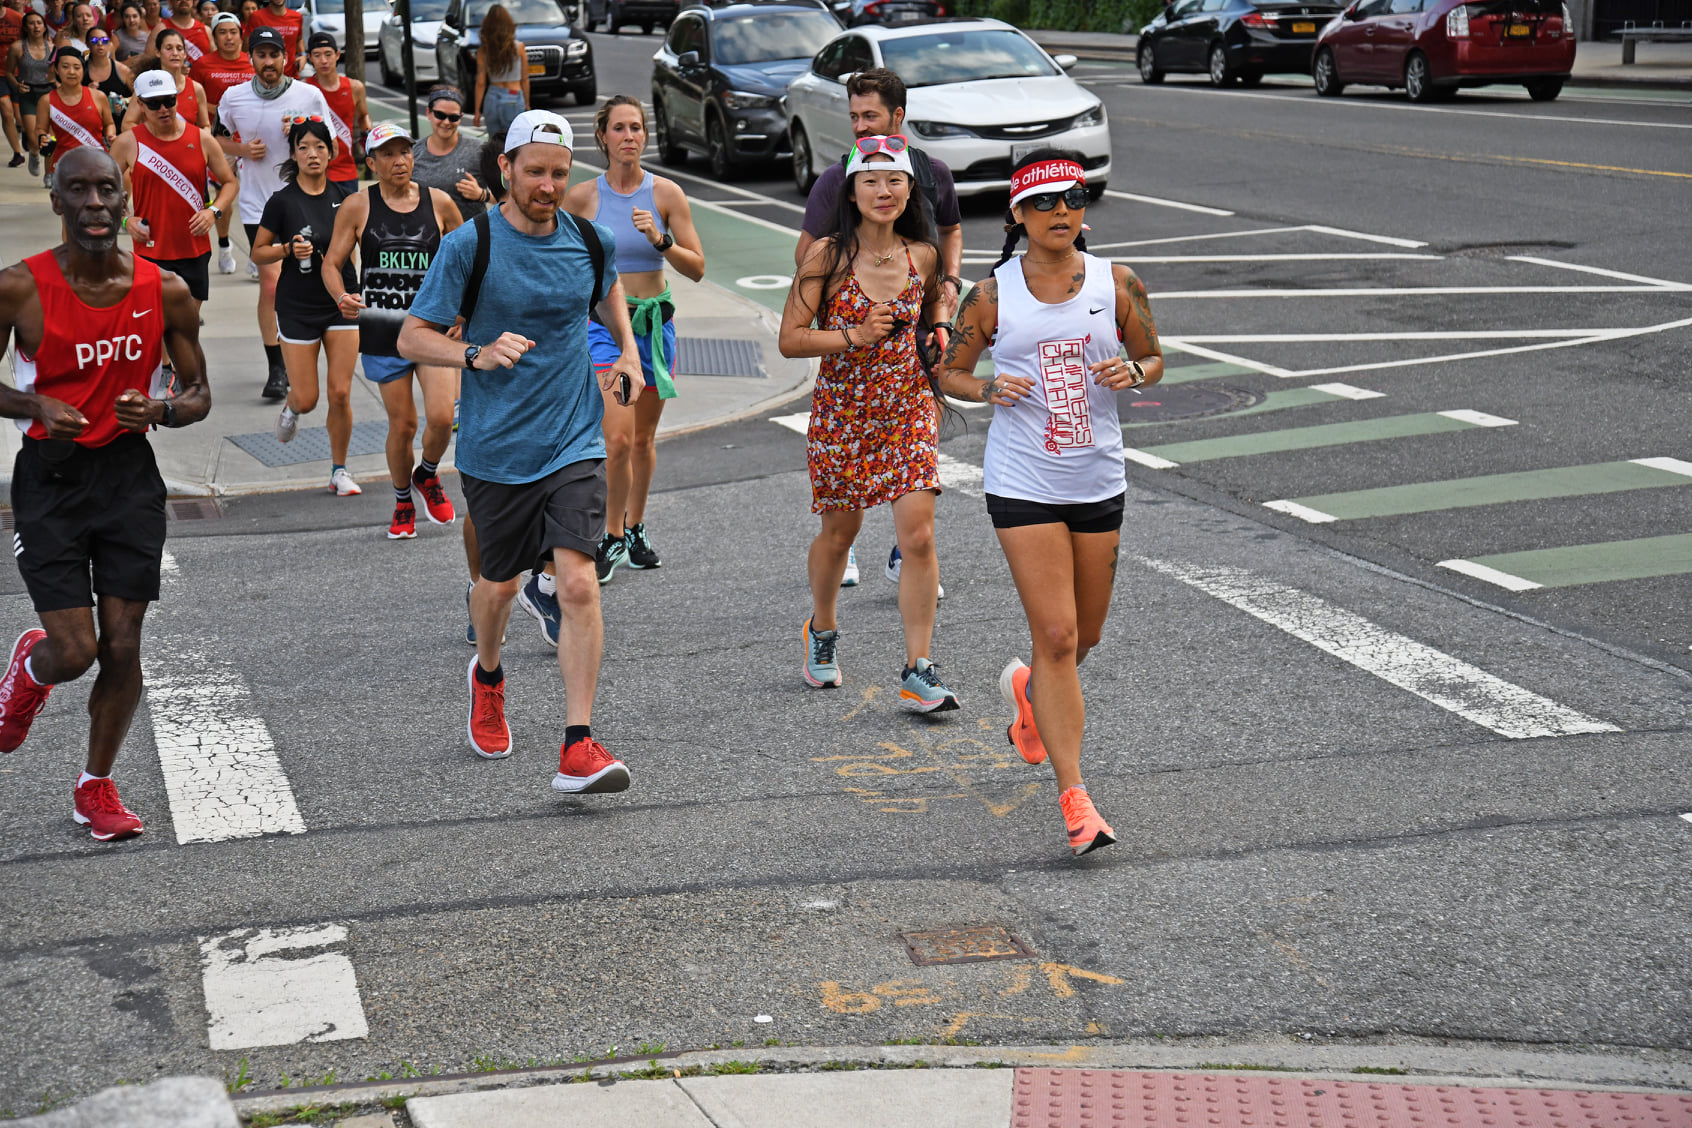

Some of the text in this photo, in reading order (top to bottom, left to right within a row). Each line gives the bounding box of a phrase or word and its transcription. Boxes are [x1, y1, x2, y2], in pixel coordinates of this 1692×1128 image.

[55, 113, 86, 138] PROSPECT
[148, 156, 193, 195] PROSPECT
[380, 251, 429, 269] BKLYN
[75, 333, 142, 370] PPTC
[1042, 343, 1074, 446] CHINATOWN
[1063, 343, 1092, 444] RUNNERS
